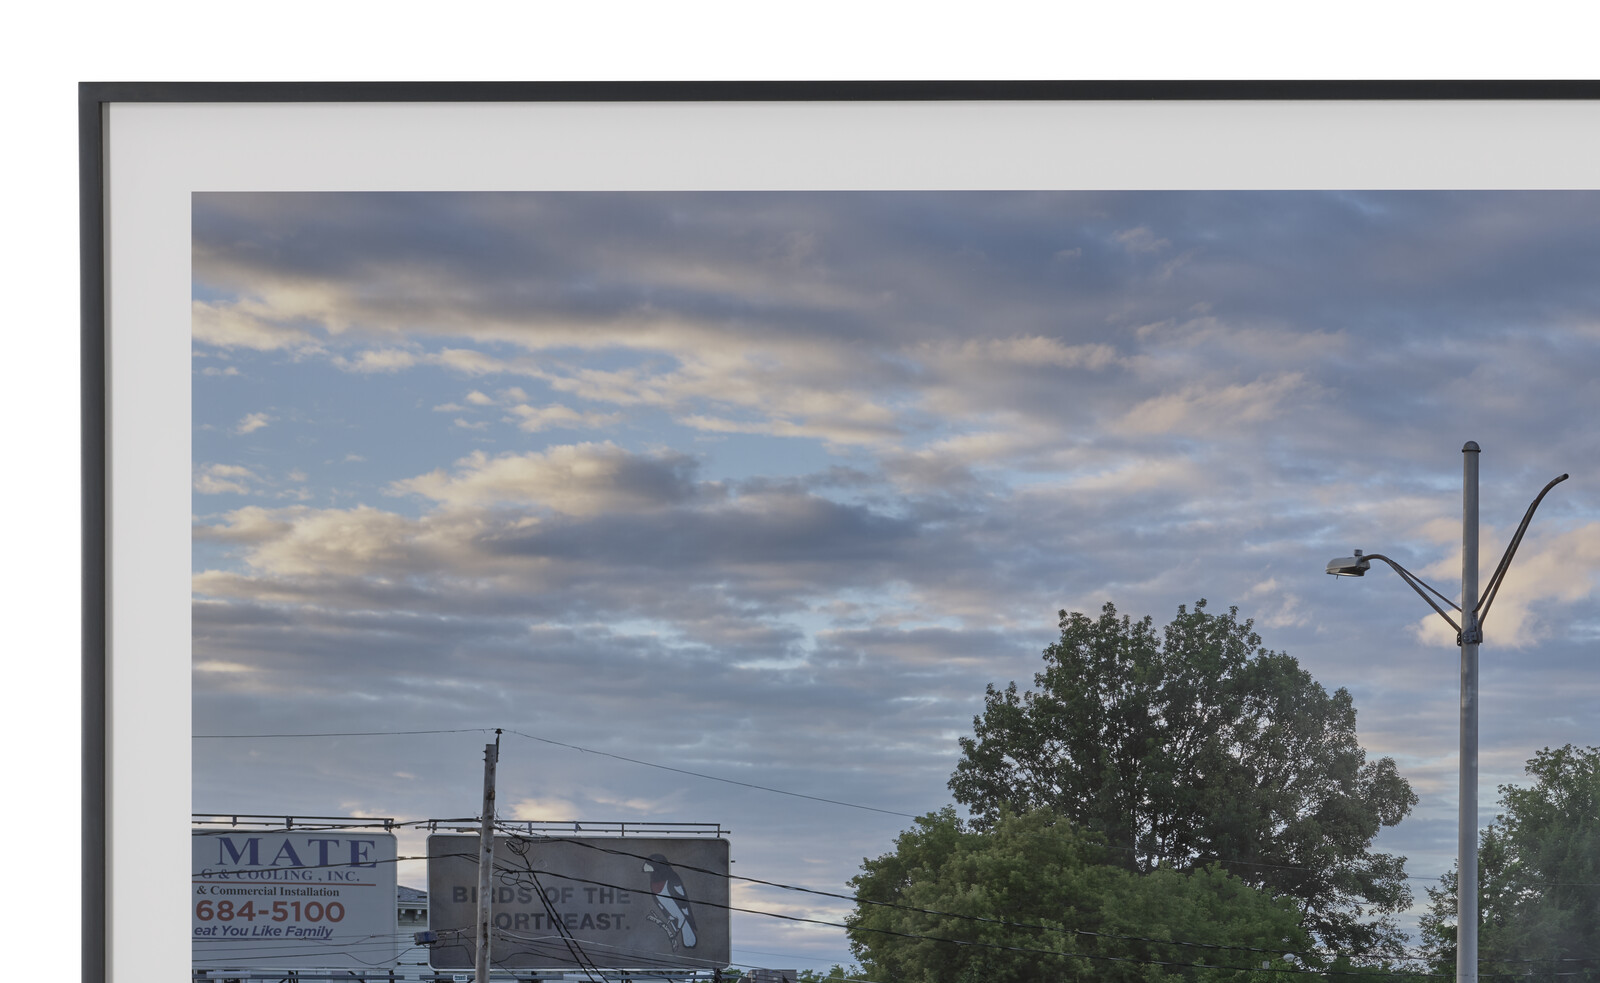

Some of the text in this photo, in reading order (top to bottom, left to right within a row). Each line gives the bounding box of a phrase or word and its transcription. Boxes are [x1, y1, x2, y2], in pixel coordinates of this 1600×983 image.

[215, 837, 376, 868] MATE
[327, 872, 360, 882] INC.
[196, 885, 340, 897] & Commercial Installation
[546, 887, 574, 904] OF
[583, 887, 631, 905] THE
[196, 899, 345, 923] 684-5100
[494, 912, 631, 931] ORTHEAST.
[194, 925, 334, 939] eat You Like Family
